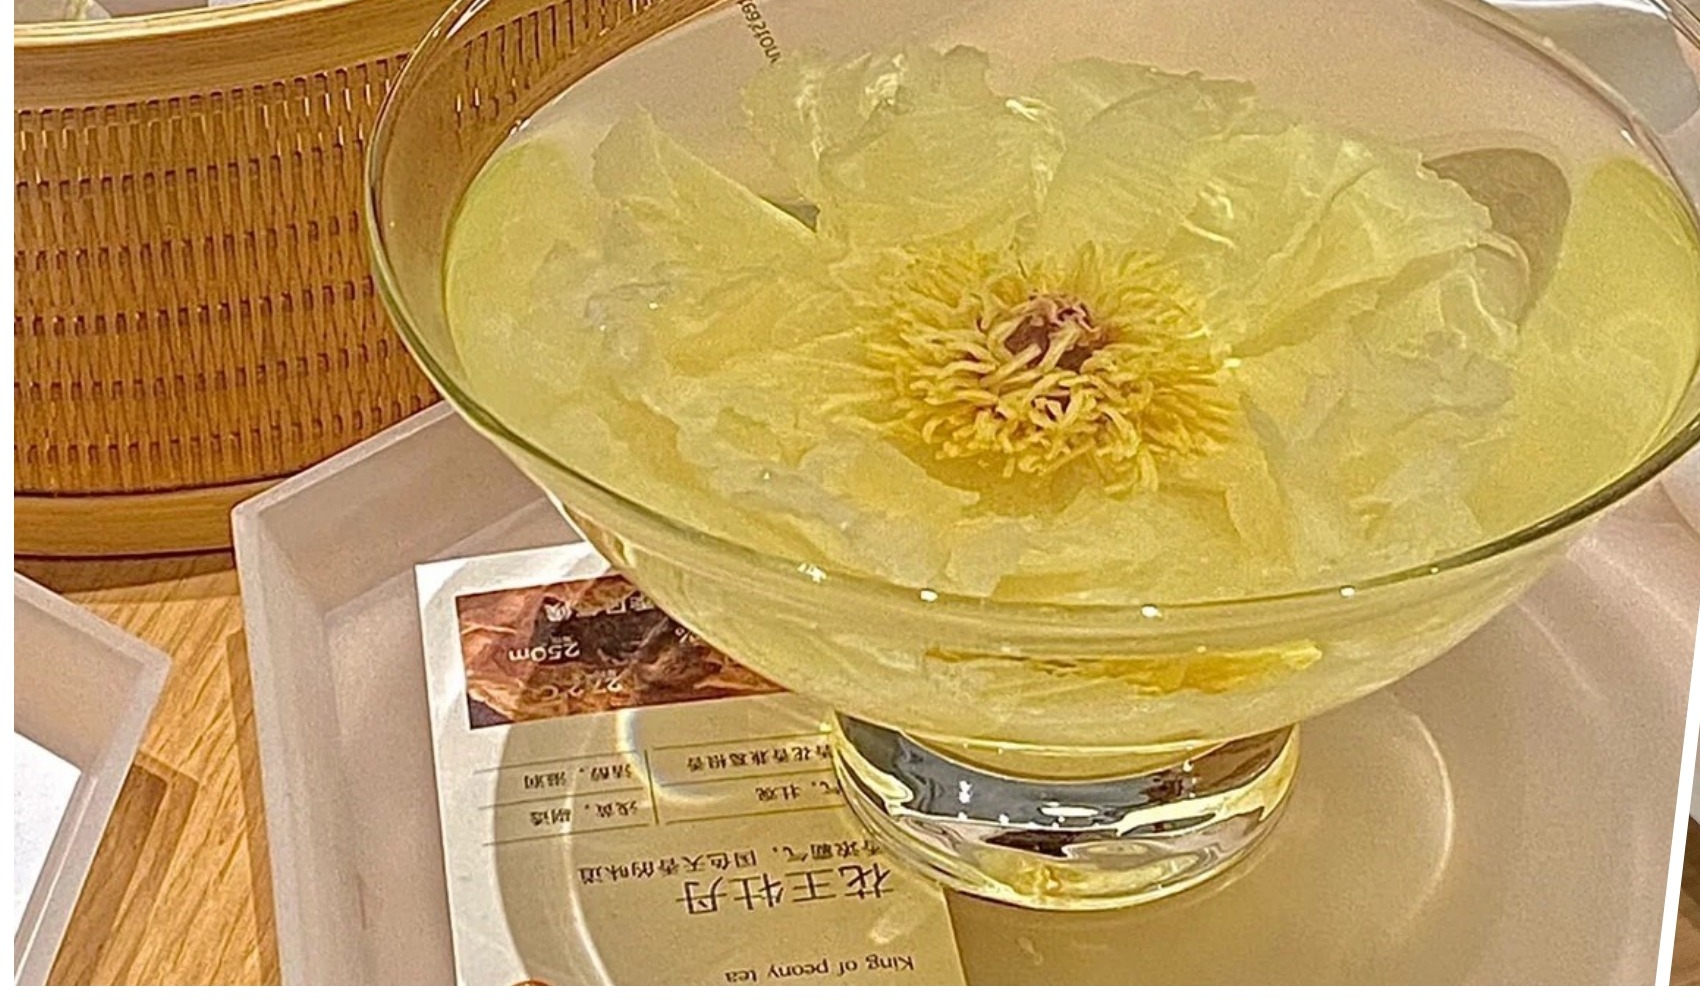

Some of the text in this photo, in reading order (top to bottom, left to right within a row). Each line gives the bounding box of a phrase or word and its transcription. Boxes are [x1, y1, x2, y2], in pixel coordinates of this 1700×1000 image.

[675, 862, 895, 916] 花王牡丹
[725, 954, 915, 983] King of peony tea
